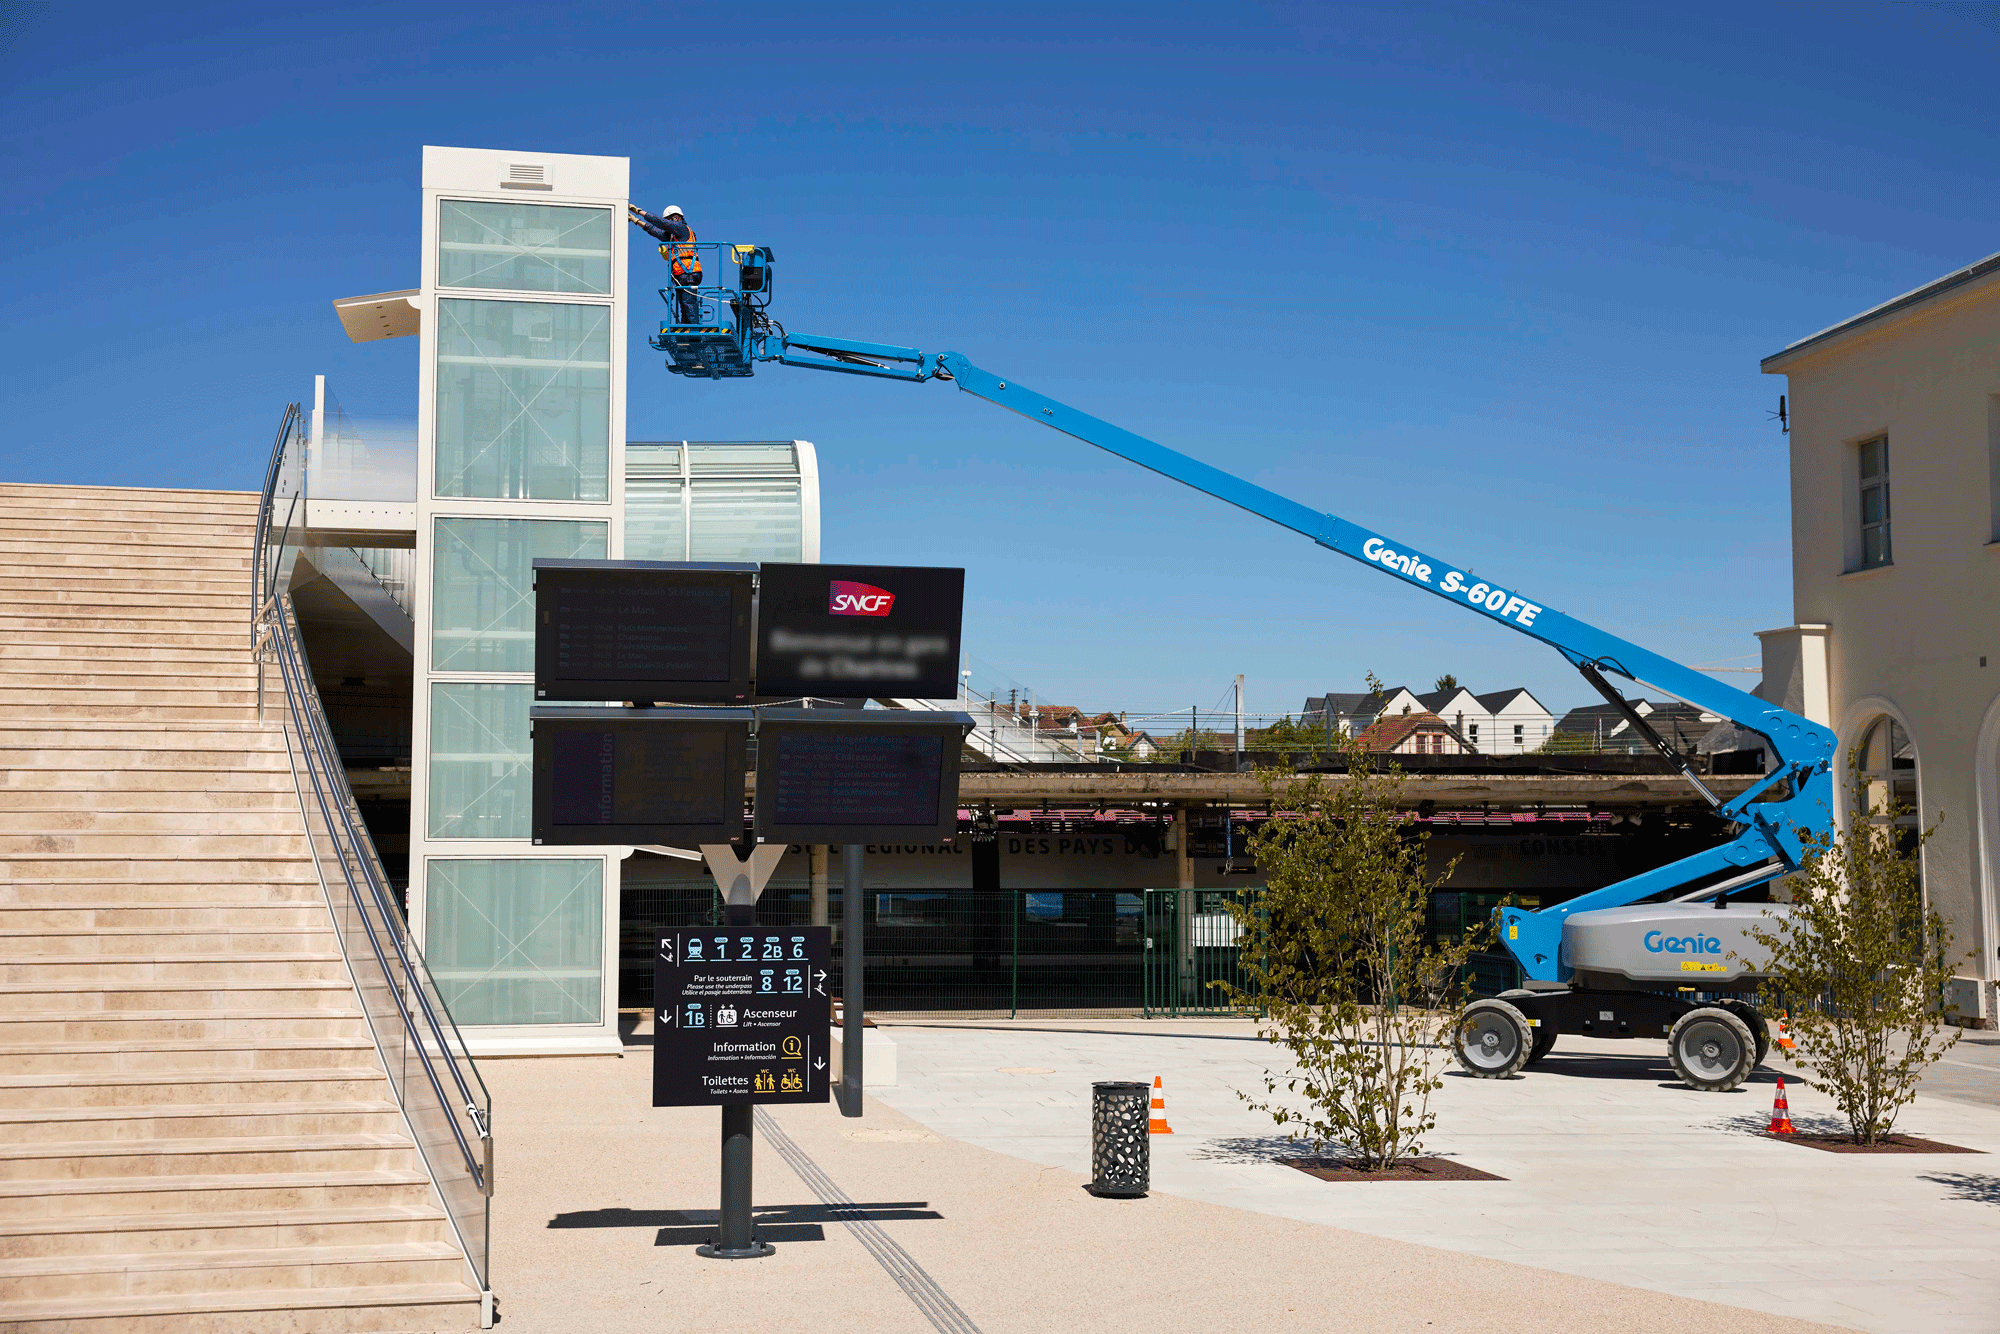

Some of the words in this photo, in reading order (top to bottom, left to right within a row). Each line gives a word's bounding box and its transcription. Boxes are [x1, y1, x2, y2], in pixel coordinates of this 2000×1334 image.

[1363, 538, 1431, 582] Genie
[1440, 571, 1542, 627] S-60FE
[832, 594, 890, 612] SNCF
[1008, 838, 1050, 855] DES
[1058, 838, 1114, 855] PAYS
[1644, 930, 1722, 954] Genie
[717, 944, 725, 958] 1
[742, 944, 752, 958] 2
[762, 944, 782, 958] 2B
[793, 943, 803, 958] 6
[762, 976, 772, 991] 8
[783, 976, 802, 990] 12
[685, 1010, 705, 1025] 1B
[743, 1009, 797, 1018] Ascenseur
[713, 1042, 776, 1052] Information
[702, 1076, 749, 1086] Toilettes
